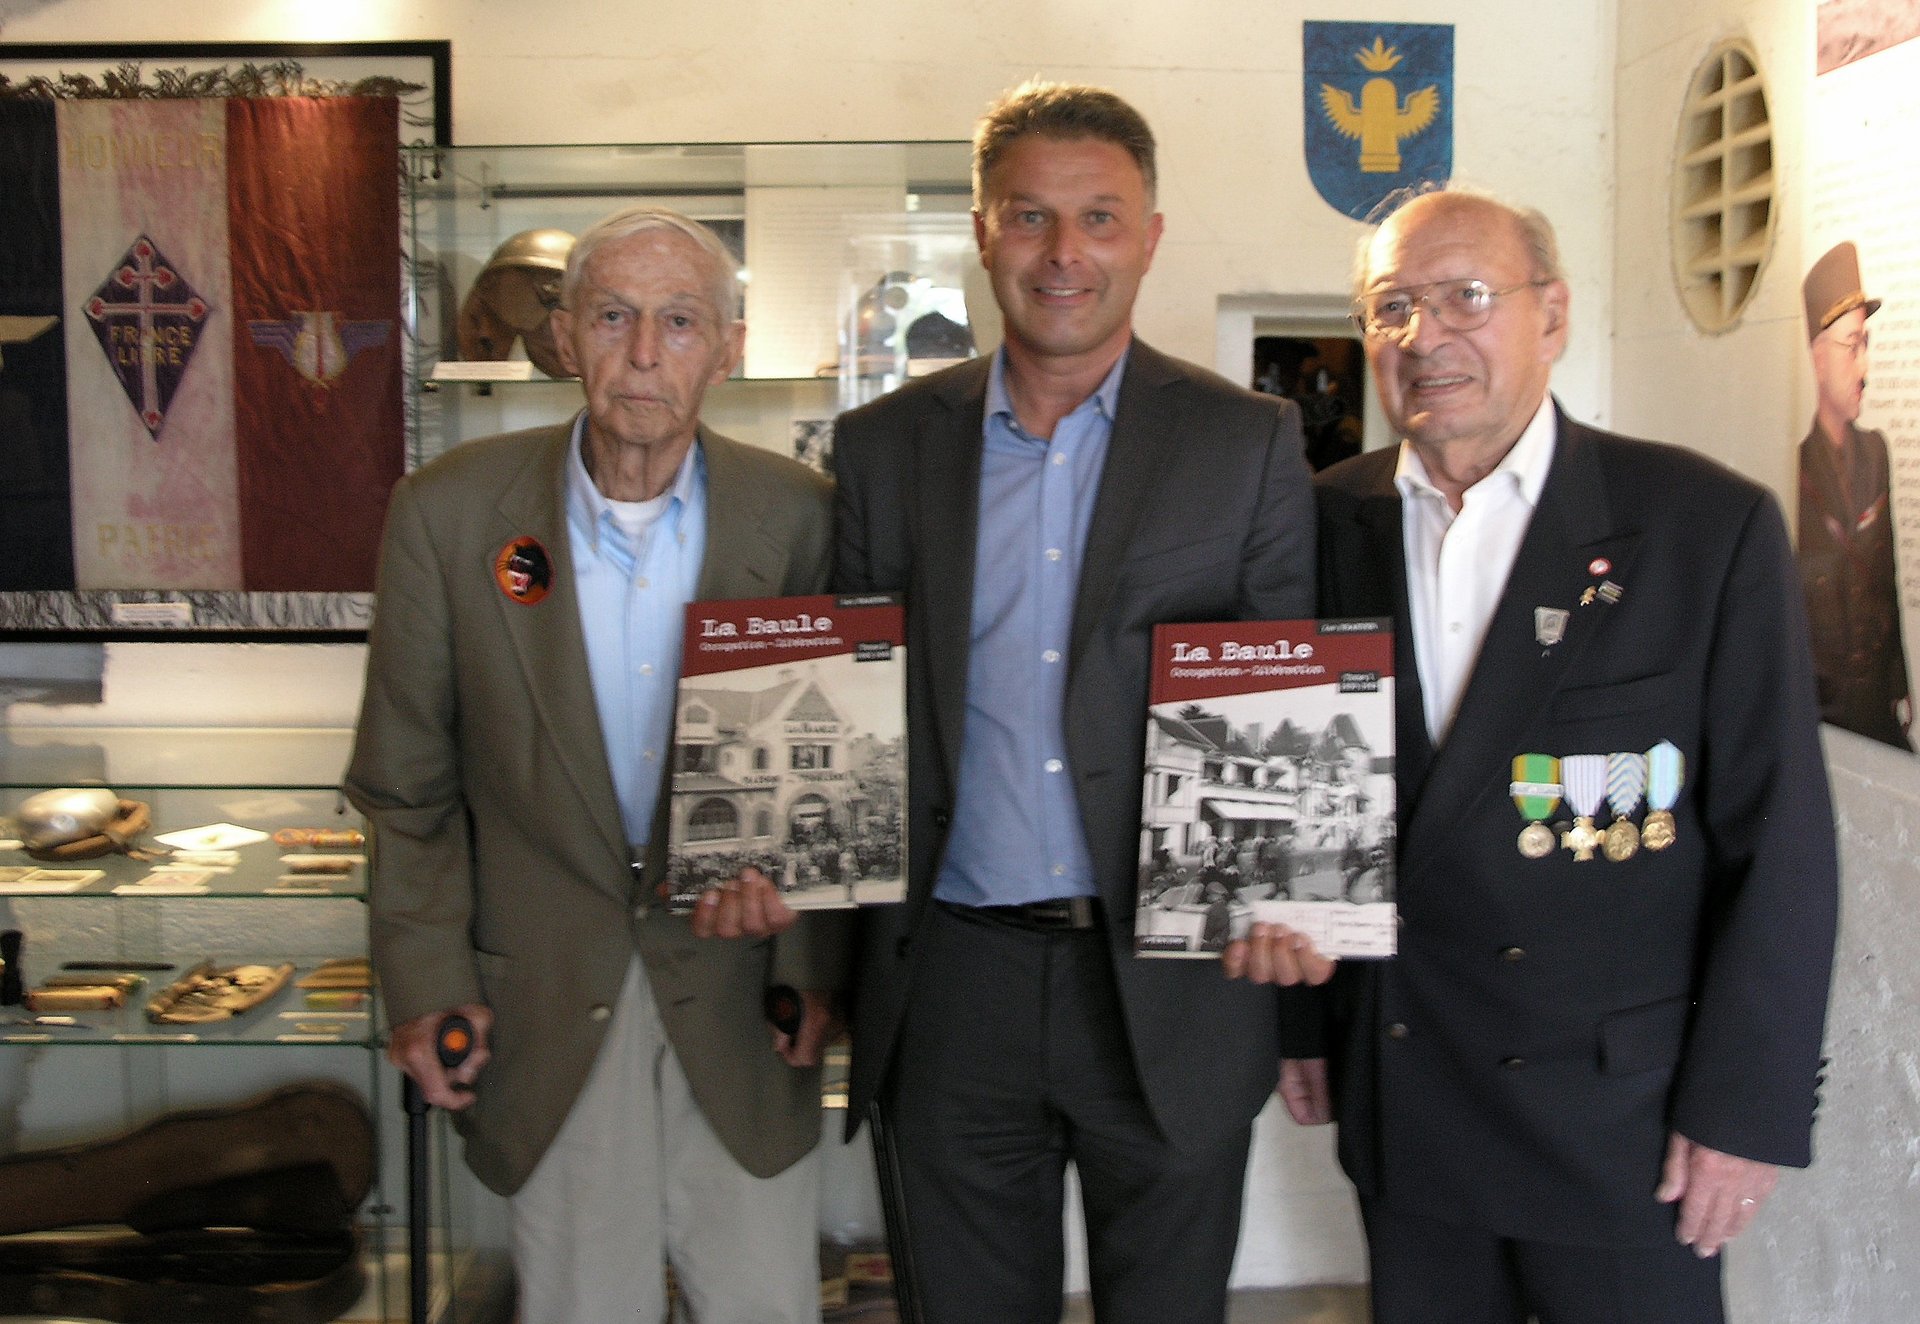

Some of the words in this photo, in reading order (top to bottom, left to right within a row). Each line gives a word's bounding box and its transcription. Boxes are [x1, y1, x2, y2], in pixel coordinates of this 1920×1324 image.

[700, 618, 738, 637] La
[745, 613, 833, 635] Baule
[1170, 642, 1212, 662] La
[1219, 639, 1314, 660] Baule
